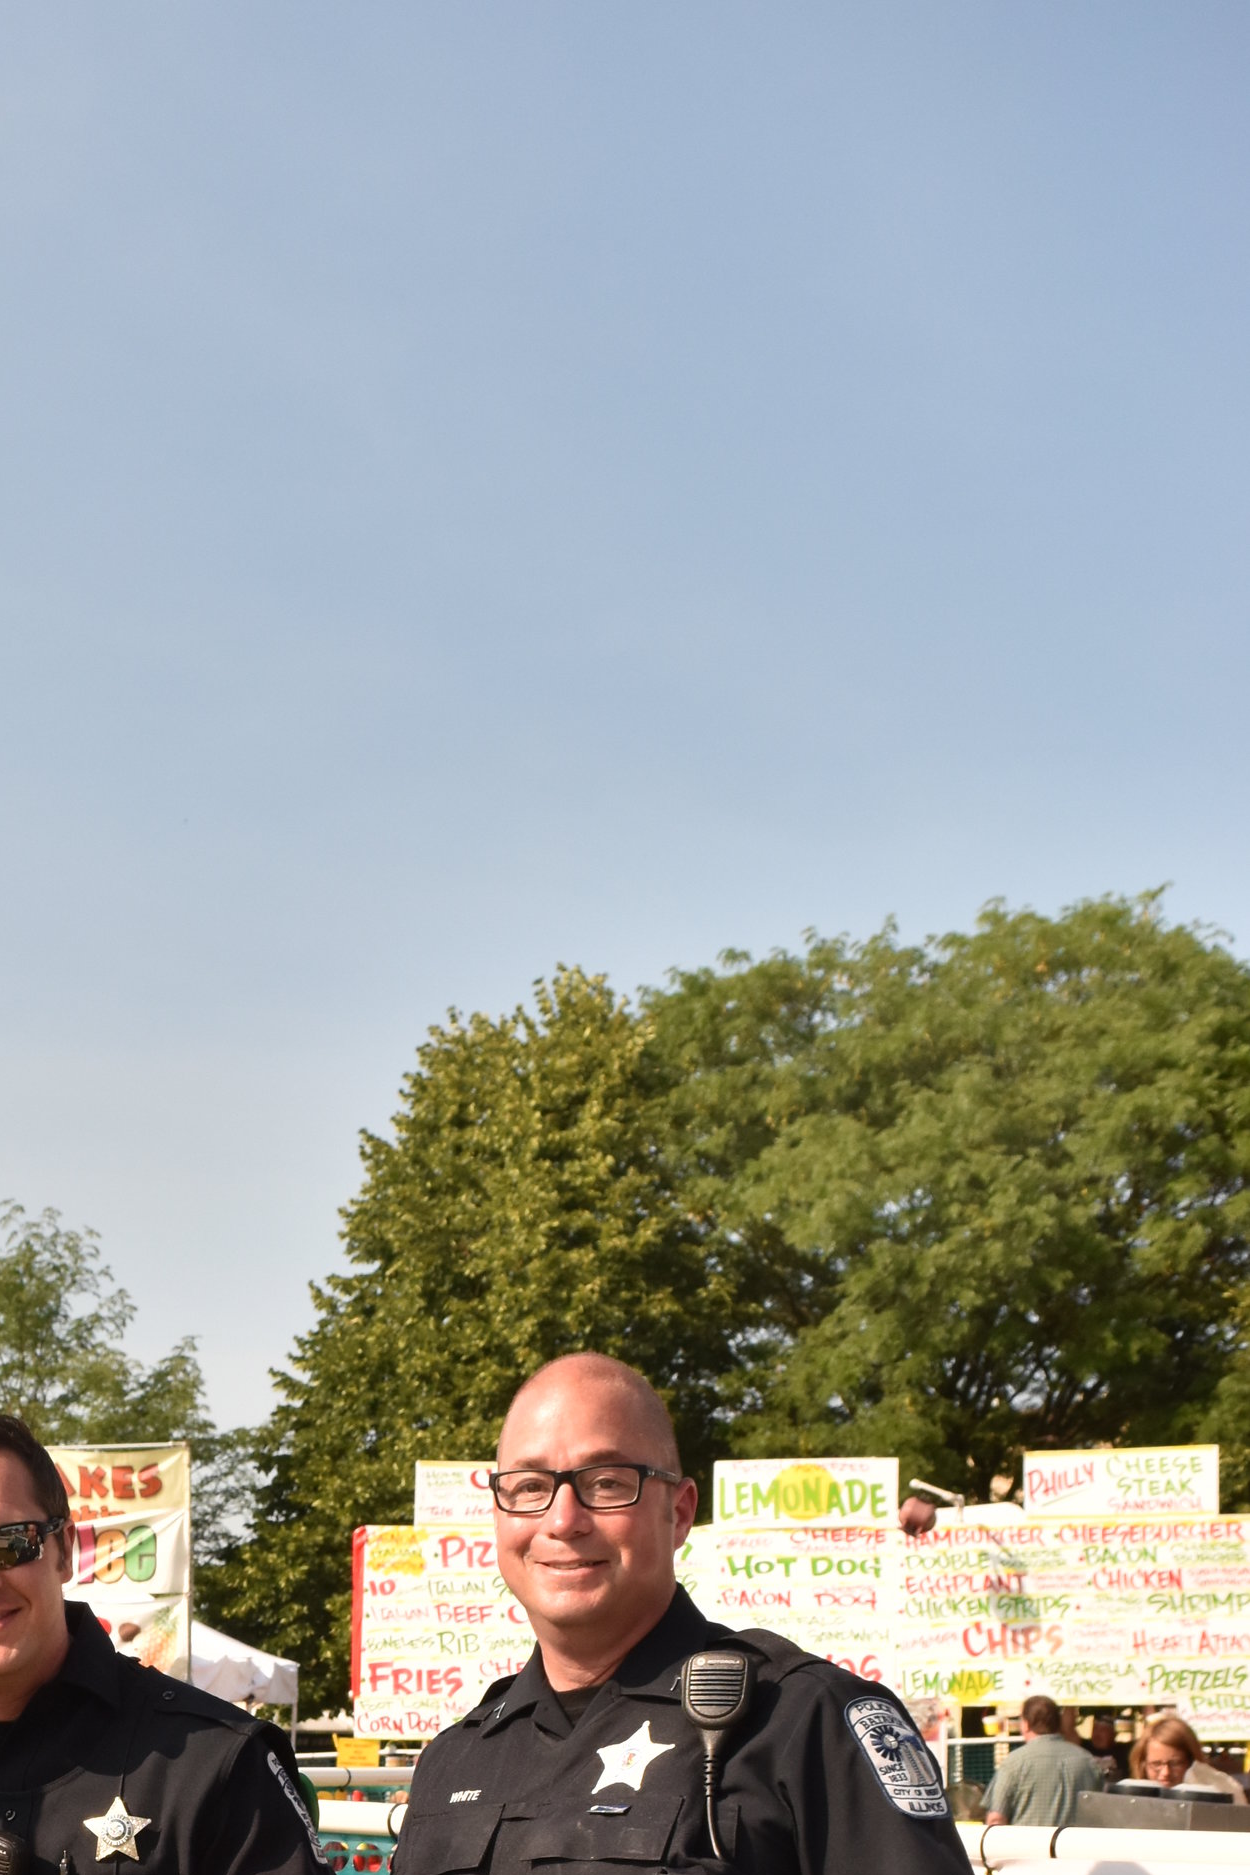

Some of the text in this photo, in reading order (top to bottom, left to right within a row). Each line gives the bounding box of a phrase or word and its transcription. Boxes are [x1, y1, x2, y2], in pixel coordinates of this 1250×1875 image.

[1027, 1456, 1203, 1502] PHILLY CHEESE
[1117, 1477, 1195, 1497] STEAK
[719, 1477, 888, 1521] LEMONADE
[790, 1527, 886, 1544] CHEESE
[905, 1521, 1245, 1550] HAMBURGER CHEESEBURGER
[77, 1525, 157, 1584] Ice
[438, 1535, 496, 1568] PIZ
[905, 1551, 990, 1570] DOUBLE
[1083, 1546, 1158, 1565] BACON
[727, 1555, 881, 1579] HOT DOG
[427, 1580, 486, 1595] ITALIAN
[905, 1573, 1028, 1597] EGGPLANT
[1092, 1567, 1183, 1592] CHICKEN
[721, 1589, 877, 1610] BACON DOG
[905, 1596, 991, 1619] CHICKEN
[997, 1594, 1071, 1619] STRIPS
[1147, 1591, 1250, 1614] SHRIMP
[435, 1602, 494, 1624] BEEF
[437, 1631, 481, 1654] RIB
[962, 1620, 1064, 1659] CHIPS
[1132, 1628, 1196, 1656] HEART
[368, 1662, 464, 1698] FRIES
[1025, 1662, 1139, 1679] MOZZARELLA
[1147, 1664, 1248, 1694] PRETZELS
[902, 1669, 1004, 1699] LEMONADE
[1051, 1679, 1113, 1697] STICKS
[1189, 1694, 1250, 1711] PHILL
[357, 1711, 441, 1735] CORN DOG
[879, 1762, 906, 1775] SINCE
[888, 1773, 908, 1783] 1833
[450, 1790, 482, 1803] WHITE
[894, 1788, 911, 1796] CITY
